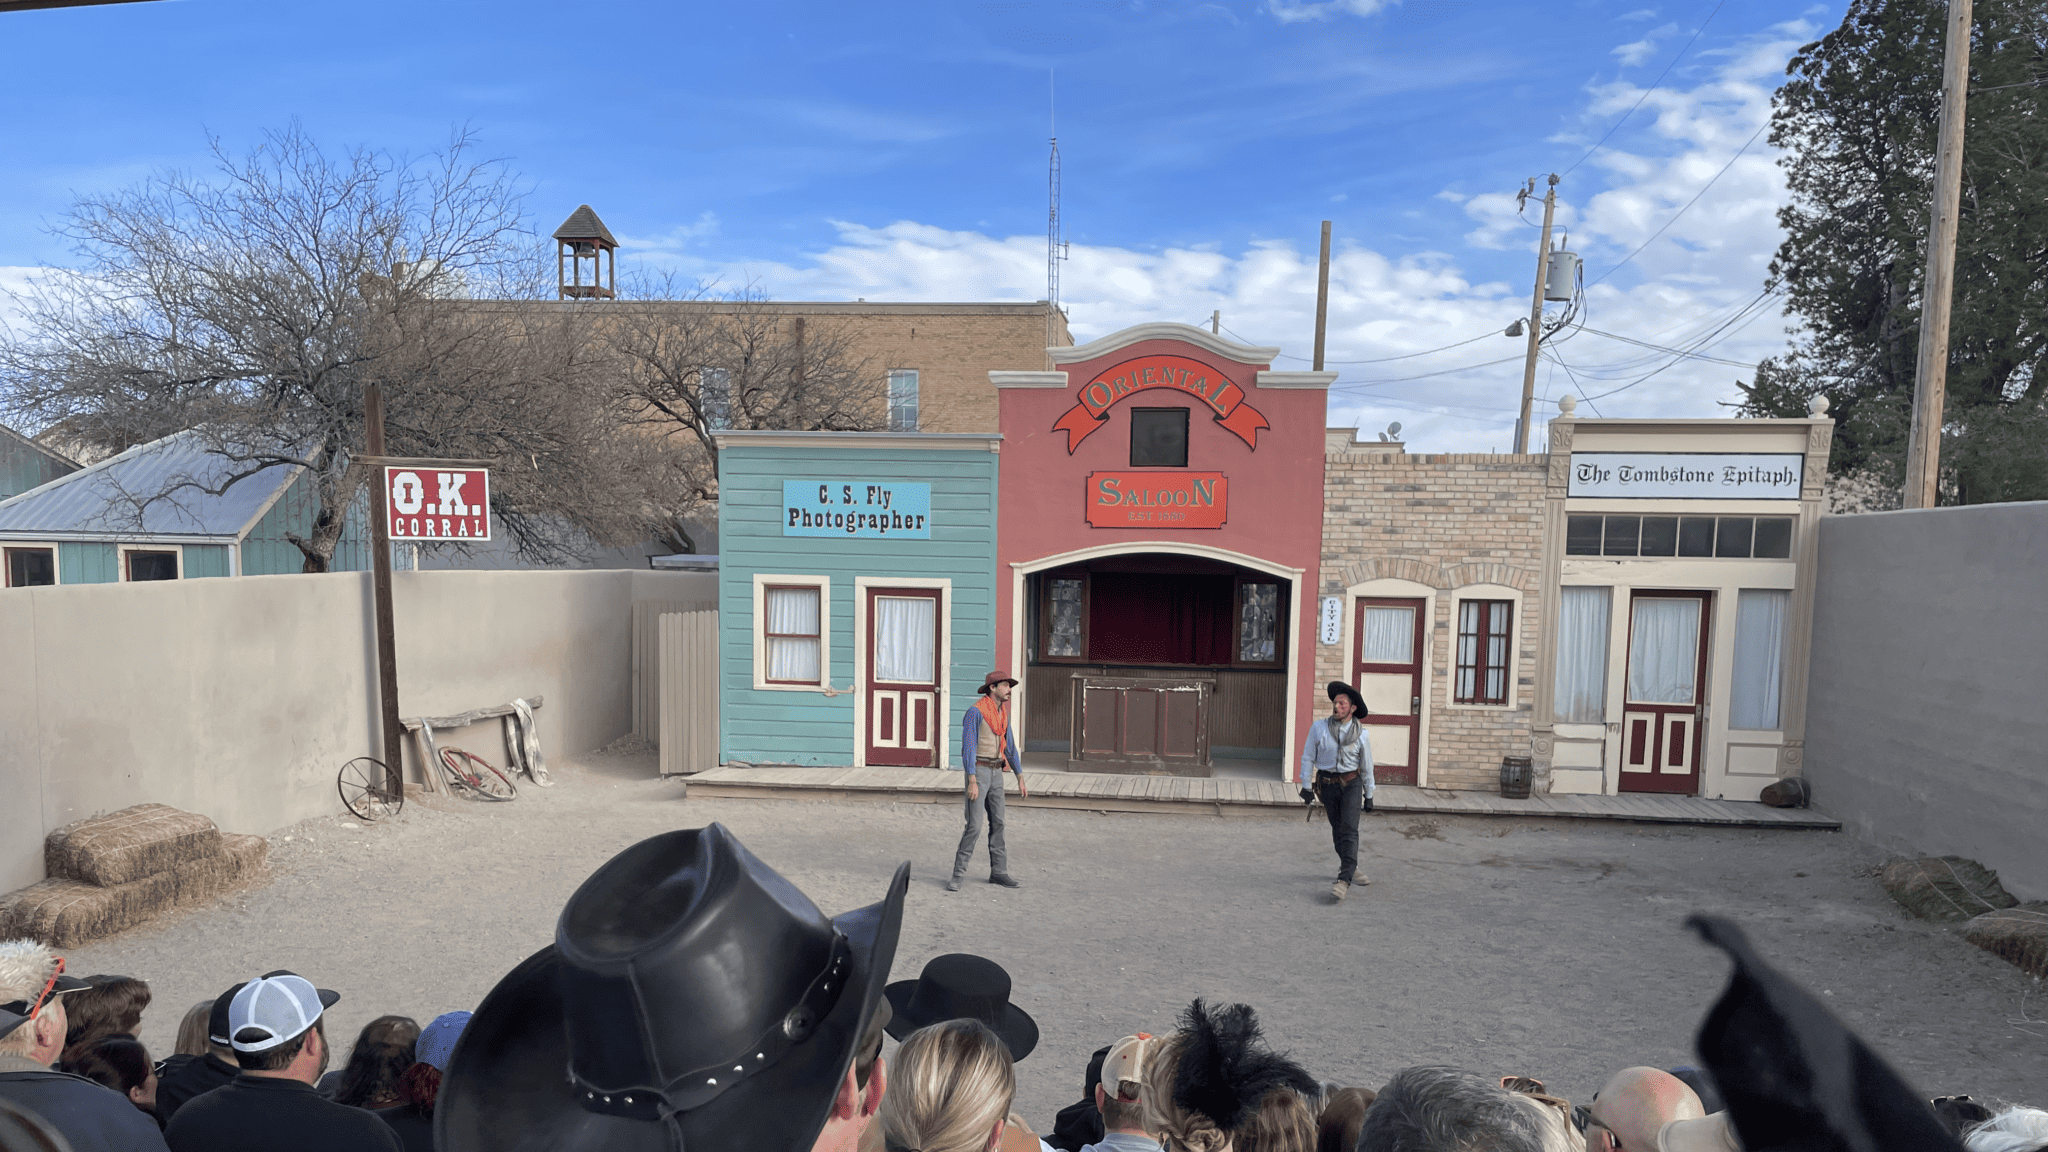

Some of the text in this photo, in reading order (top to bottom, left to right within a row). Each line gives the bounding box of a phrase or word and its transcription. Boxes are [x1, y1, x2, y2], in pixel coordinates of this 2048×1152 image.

[1577, 463, 1797, 487] The Tombstone Epitaph.
[393, 472, 481, 516] O.K.
[819, 484, 892, 510] C. S. Fly
[395, 517, 483, 537] CORRAL
[788, 507, 925, 534] Photographer
[1327, 599, 1337, 642] CITY JAIL
